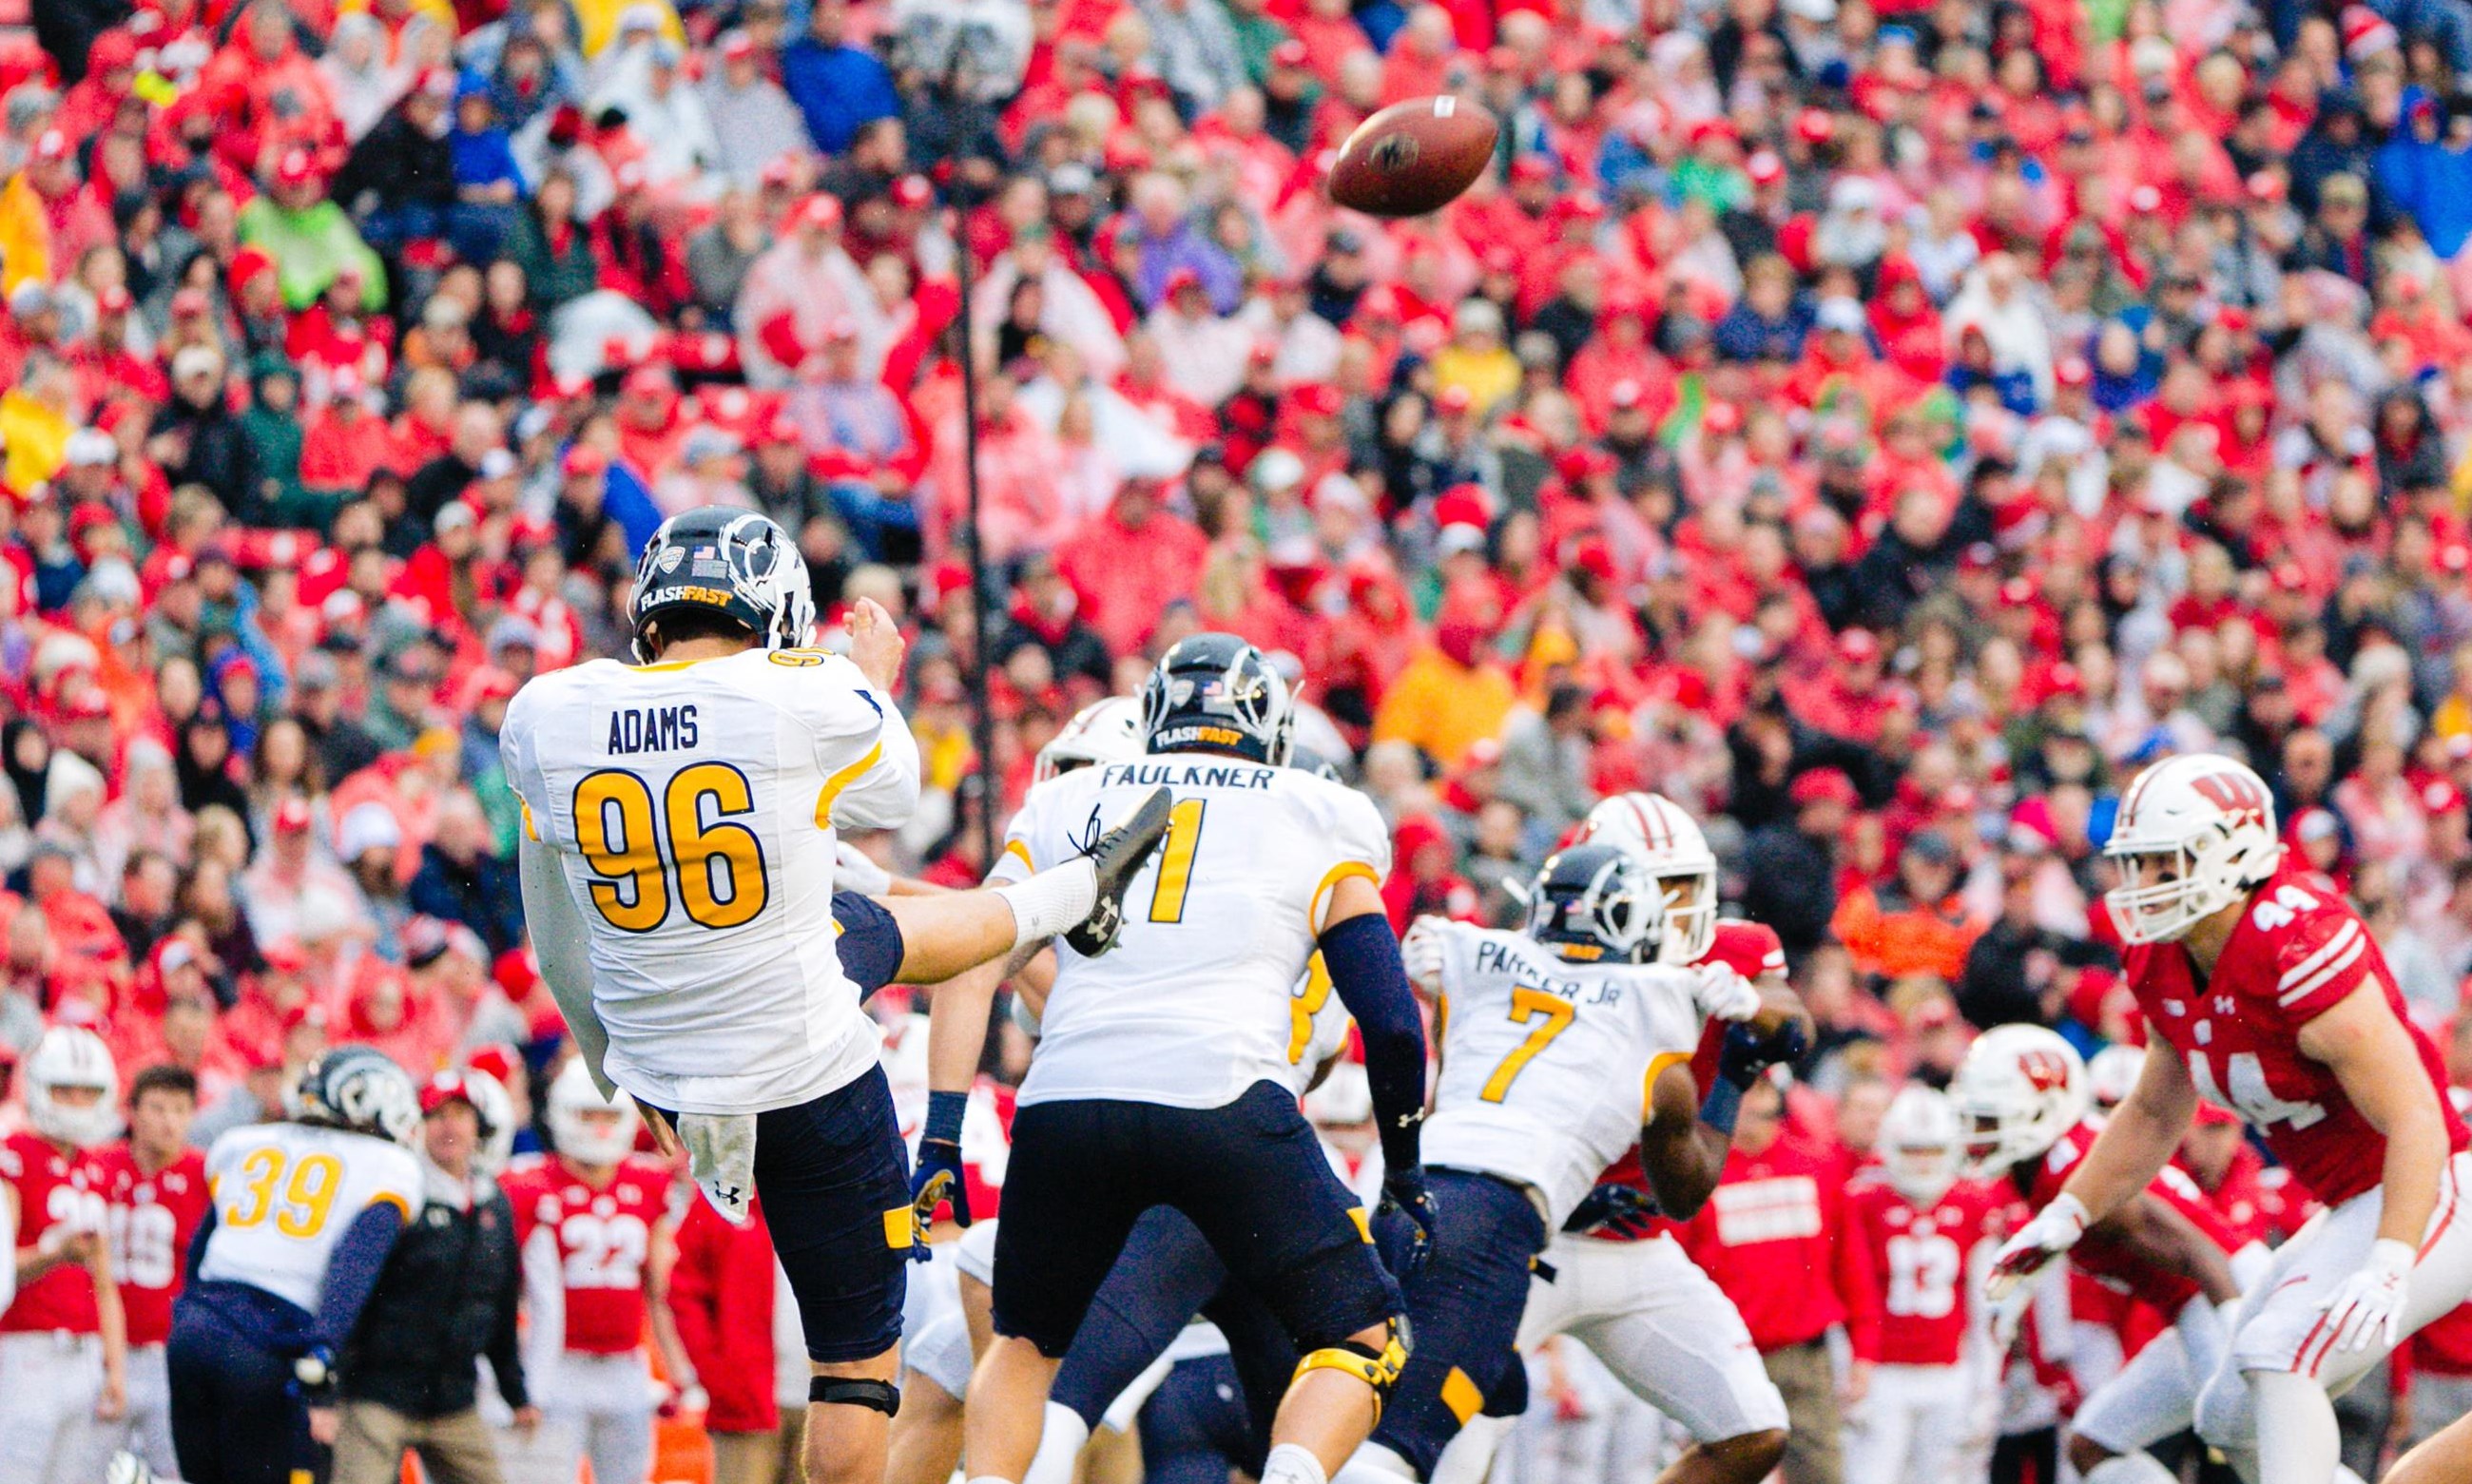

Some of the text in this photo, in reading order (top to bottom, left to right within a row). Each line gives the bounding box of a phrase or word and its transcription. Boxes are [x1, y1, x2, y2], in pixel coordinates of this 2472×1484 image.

[608, 704, 699, 756] ADAMS
[1101, 763, 1275, 790] FAULKNER
[572, 761, 769, 934] 96
[1479, 983, 1577, 1104] 7
[226, 1148, 343, 1239] 39
[560, 1213, 648, 1290] 22
